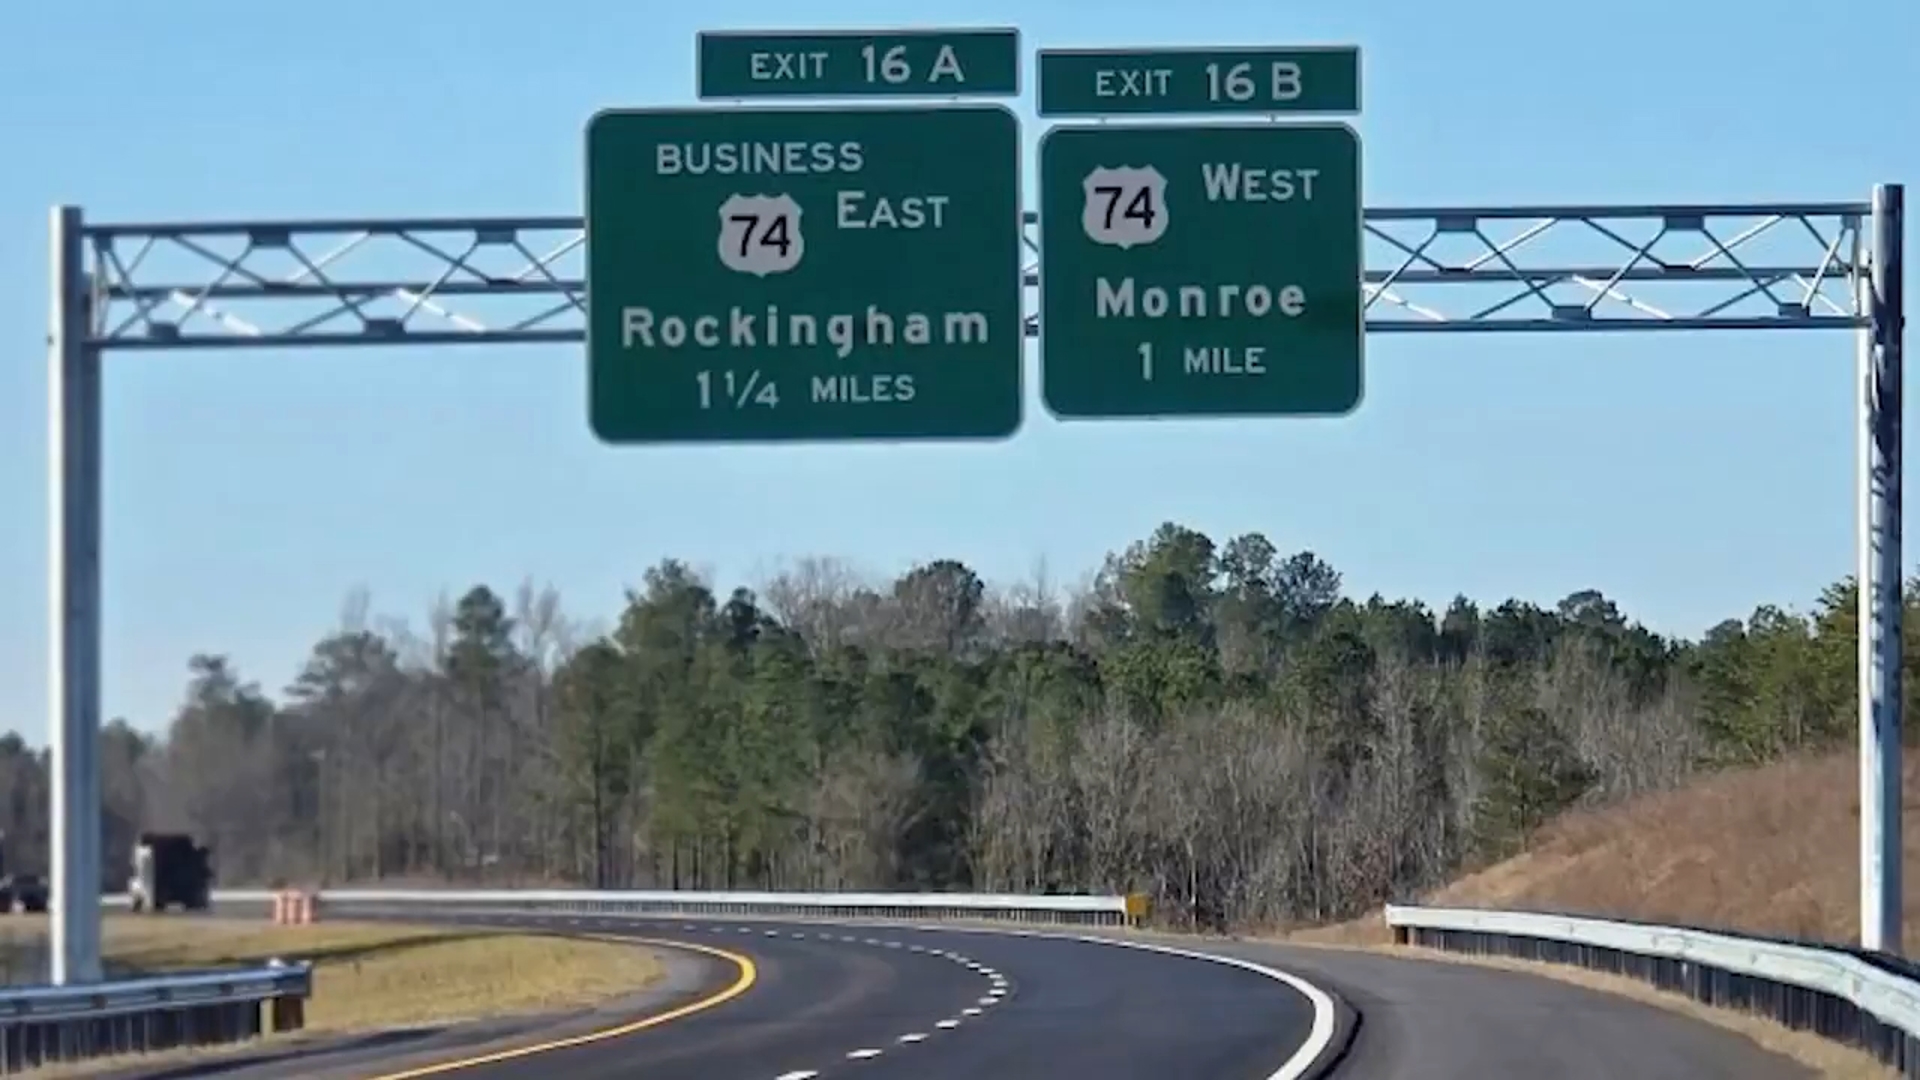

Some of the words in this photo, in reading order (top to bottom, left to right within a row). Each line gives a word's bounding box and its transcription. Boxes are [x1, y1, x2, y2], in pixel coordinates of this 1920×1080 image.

[751, 52, 829, 79] EXIT
[862, 45, 911, 83] 16
[929, 44, 964, 82] A
[1096, 69, 1172, 96] EXIT
[1206, 62, 1255, 101] 16
[1271, 62, 1302, 100] B
[657, 141, 863, 174] BUSINESS
[1202, 163, 1319, 201] WEST
[837, 190, 949, 229] EAST
[1094, 185, 1156, 230] 74
[729, 214, 791, 258] 74
[1096, 277, 1305, 318] Monroe
[623, 305, 988, 358] Rockingham
[1137, 342, 1152, 380] 1
[1184, 347, 1266, 374] MILE
[812, 374, 915, 403] MILES
